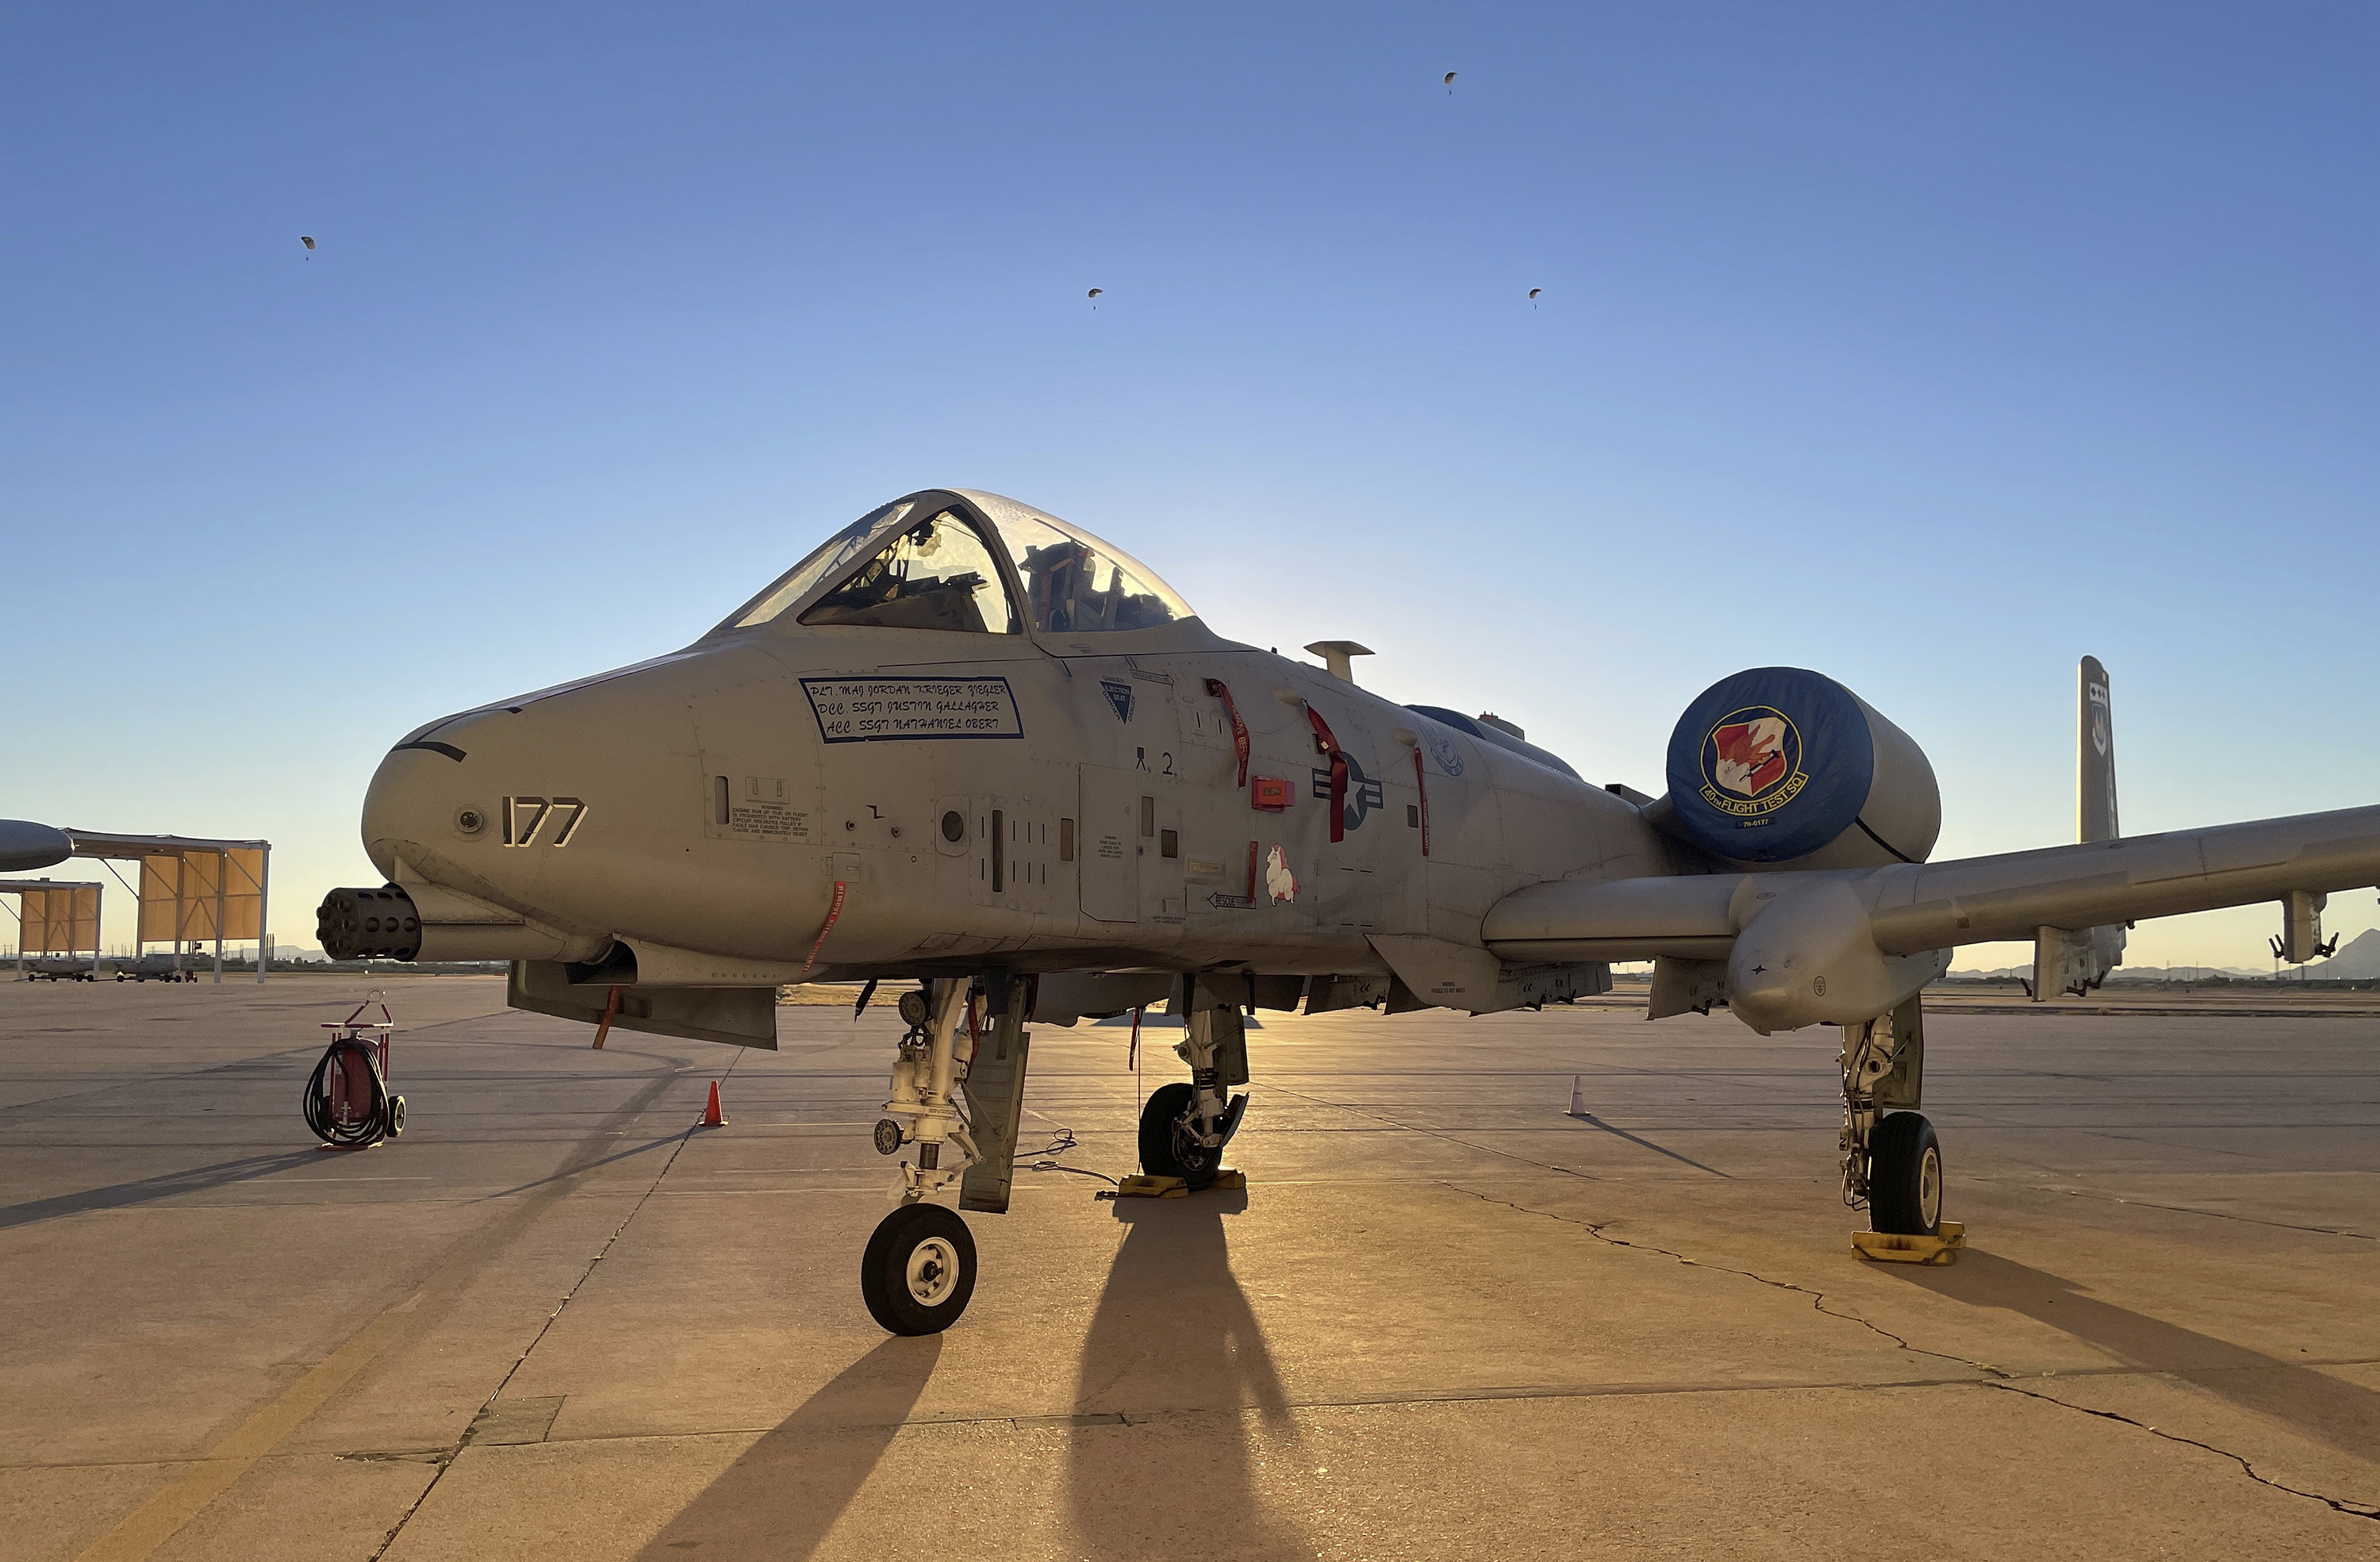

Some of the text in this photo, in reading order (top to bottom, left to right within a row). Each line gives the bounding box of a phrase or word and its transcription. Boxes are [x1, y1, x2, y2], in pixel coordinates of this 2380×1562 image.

[839, 685, 863, 697] MAJ
[869, 685, 911, 697] JORDAN
[968, 685, 1006, 697] ZIEGLER
[852, 701, 882, 715] SSGT
[888, 701, 931, 714] JUSTIN
[936, 700, 1000, 714] GALLAGHER
[859, 719, 889, 733] SSGT
[893, 718, 962, 730] NATHANIEL
[965, 718, 999, 729] OBERT
[1721, 799, 1760, 813] FLIGHT
[1760, 790, 1788, 810] TEST
[1787, 777, 1804, 793] SQ
[502, 796, 589, 848] 177
[832, 885, 844, 915] REMOVE
[1215, 896, 1236, 906] RESCUE
